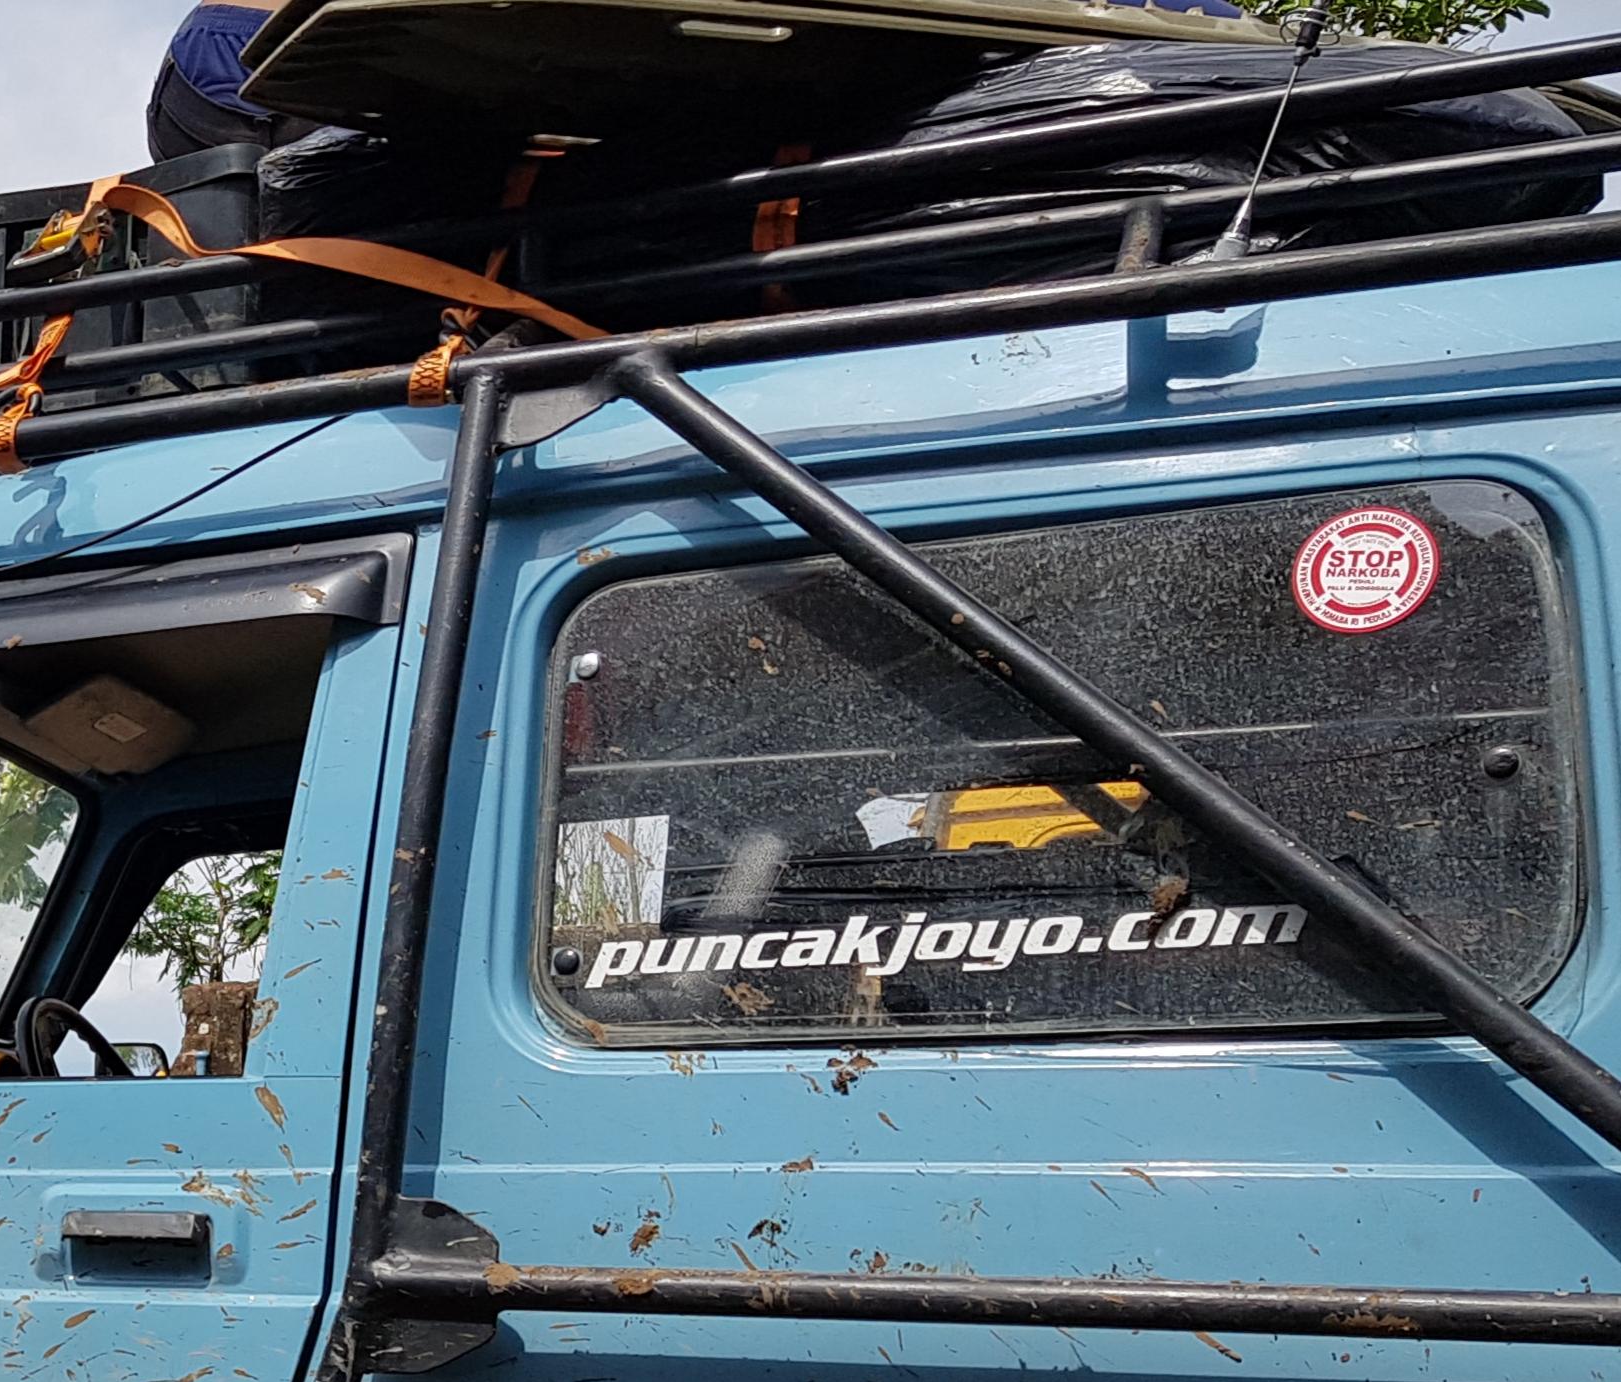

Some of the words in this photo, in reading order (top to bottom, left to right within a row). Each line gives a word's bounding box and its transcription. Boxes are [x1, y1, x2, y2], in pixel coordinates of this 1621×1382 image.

[1302, 520, 1345, 564] MASYARAKAT
[1348, 513, 1369, 526] ANTI
[1371, 513, 1412, 532] NARKOBA
[1325, 567, 1401, 578] NARKOBA
[1328, 550, 1404, 568] STOP
[584, 903, 1309, 989] puncakjoyo.com
